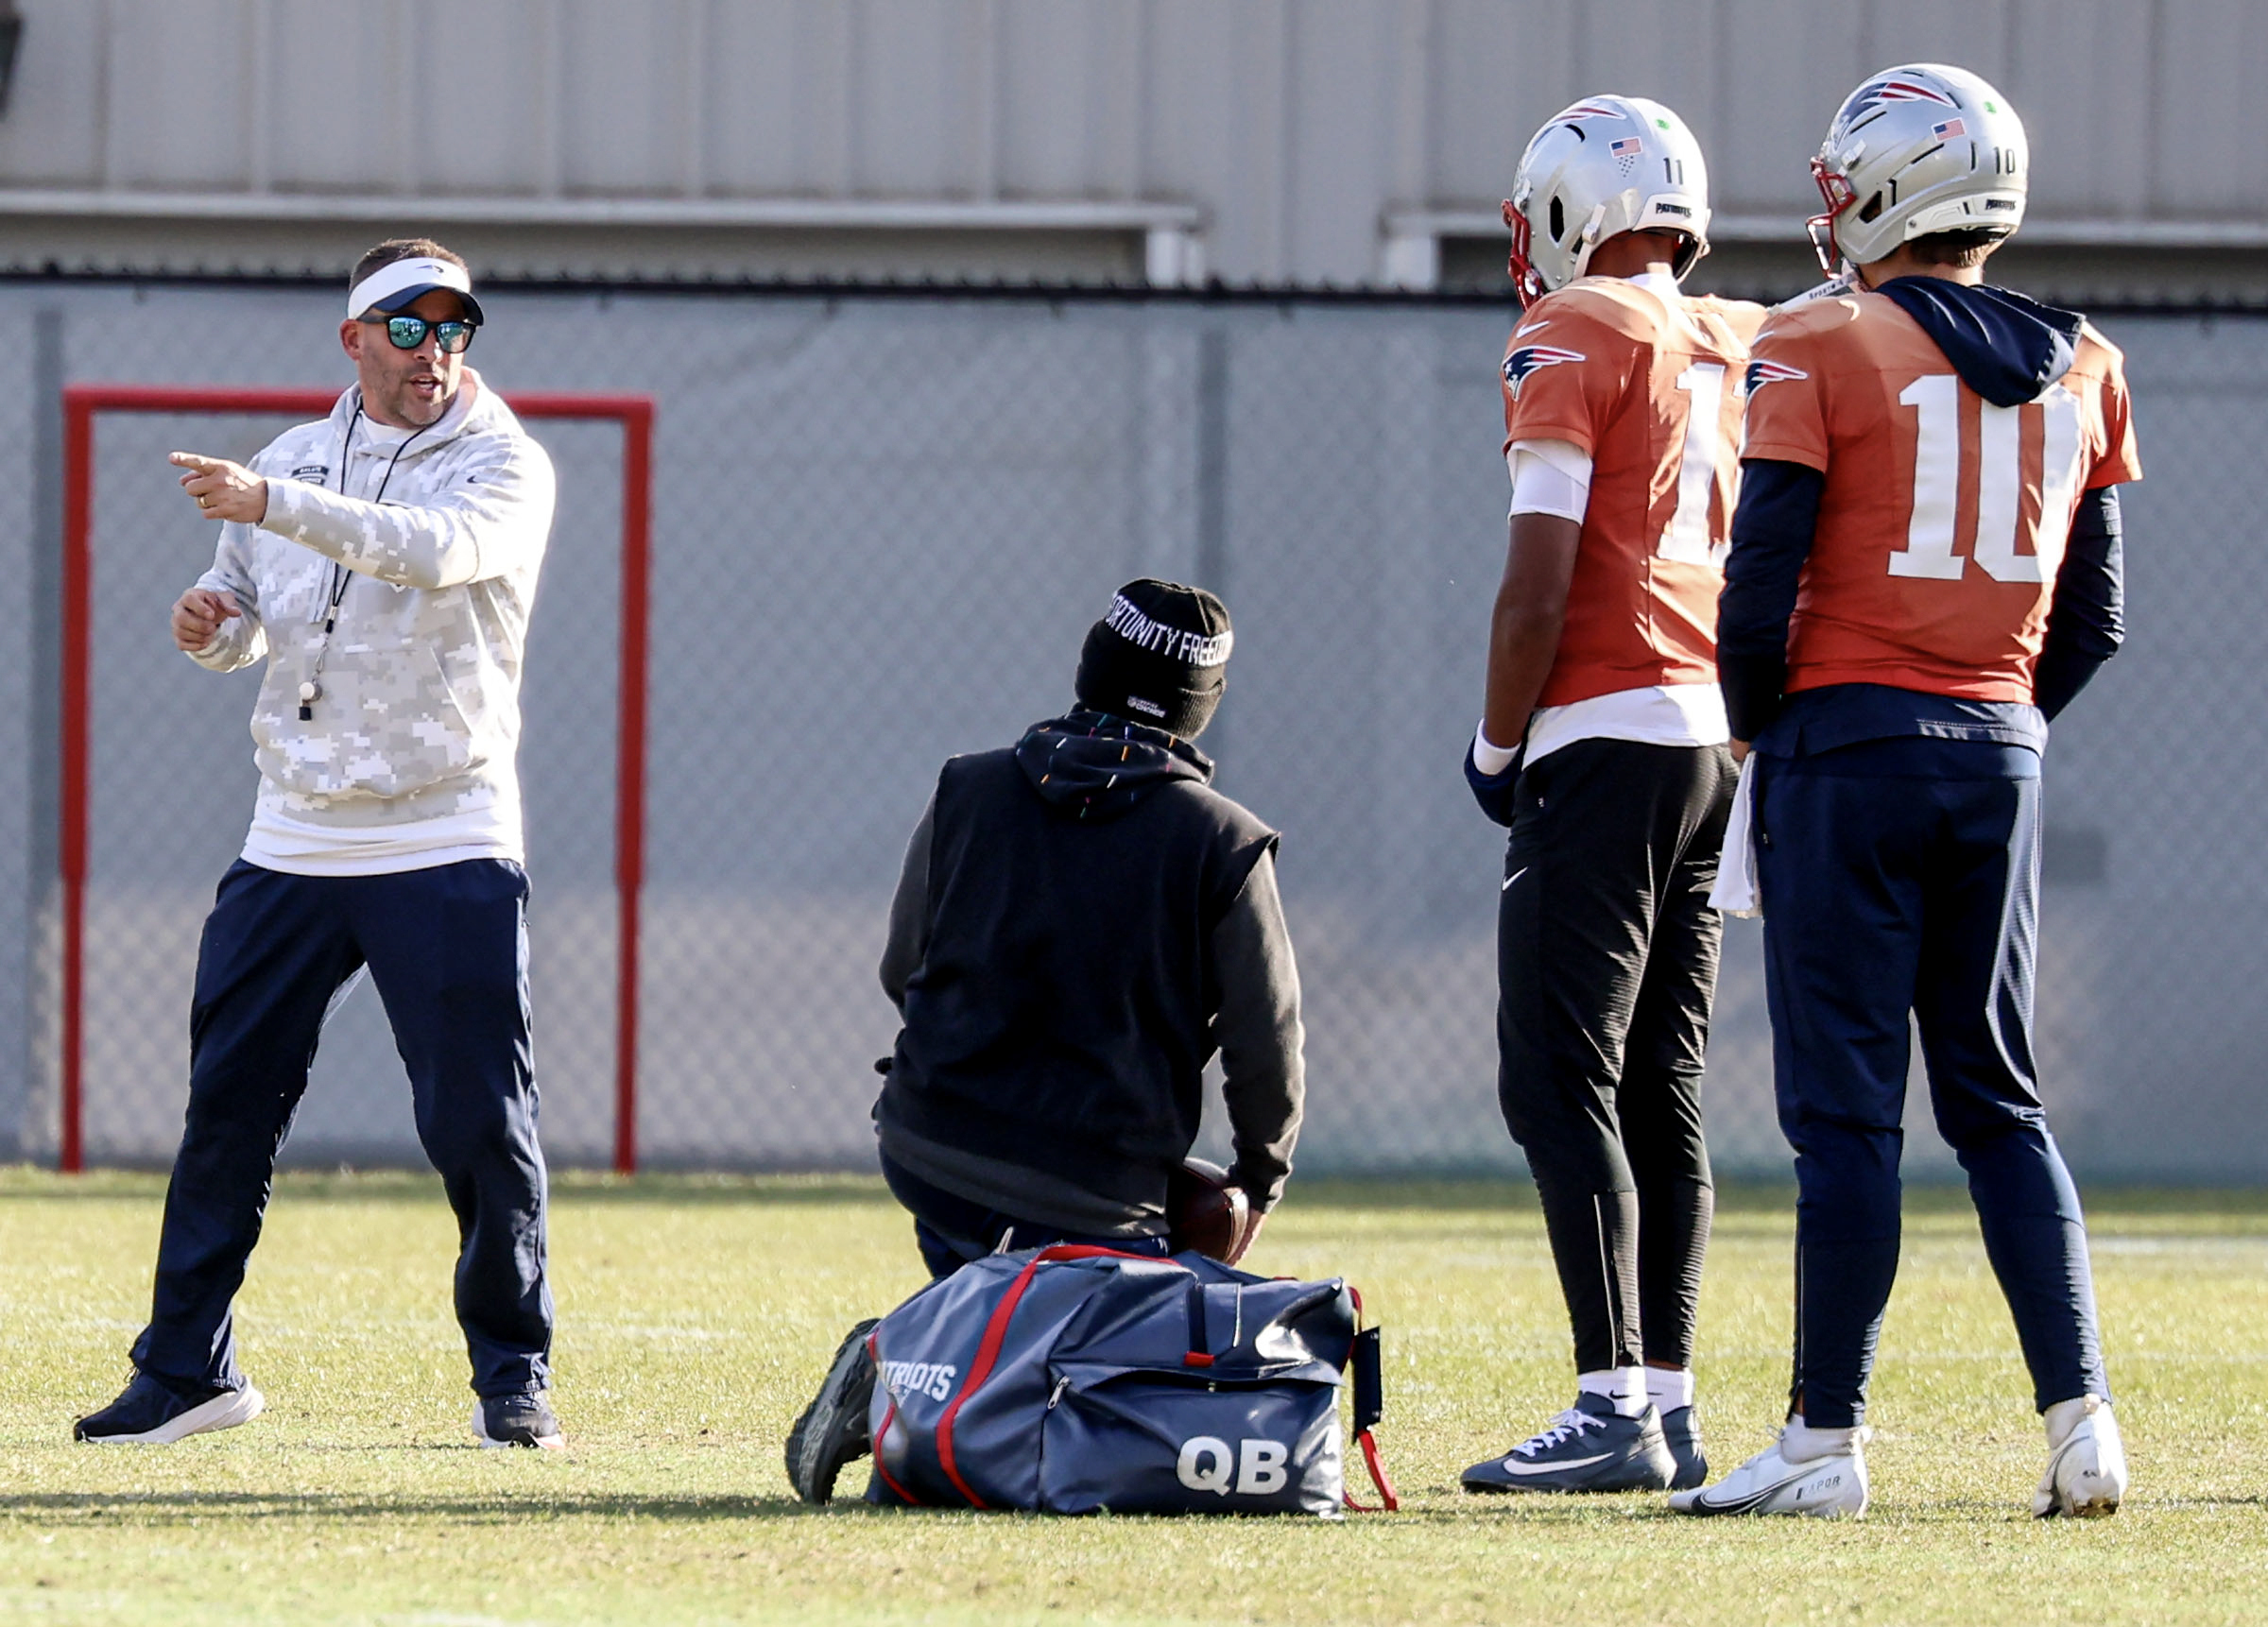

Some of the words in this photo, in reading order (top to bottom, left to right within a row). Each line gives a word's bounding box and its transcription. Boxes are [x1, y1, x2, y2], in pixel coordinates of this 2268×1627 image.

[1663, 157, 1683, 185] 11
[1993, 146, 2016, 176] 10
[1888, 374, 2082, 583] 10
[1106, 592, 1180, 656] ORTUNITY
[1177, 1436, 1288, 1497] QB
